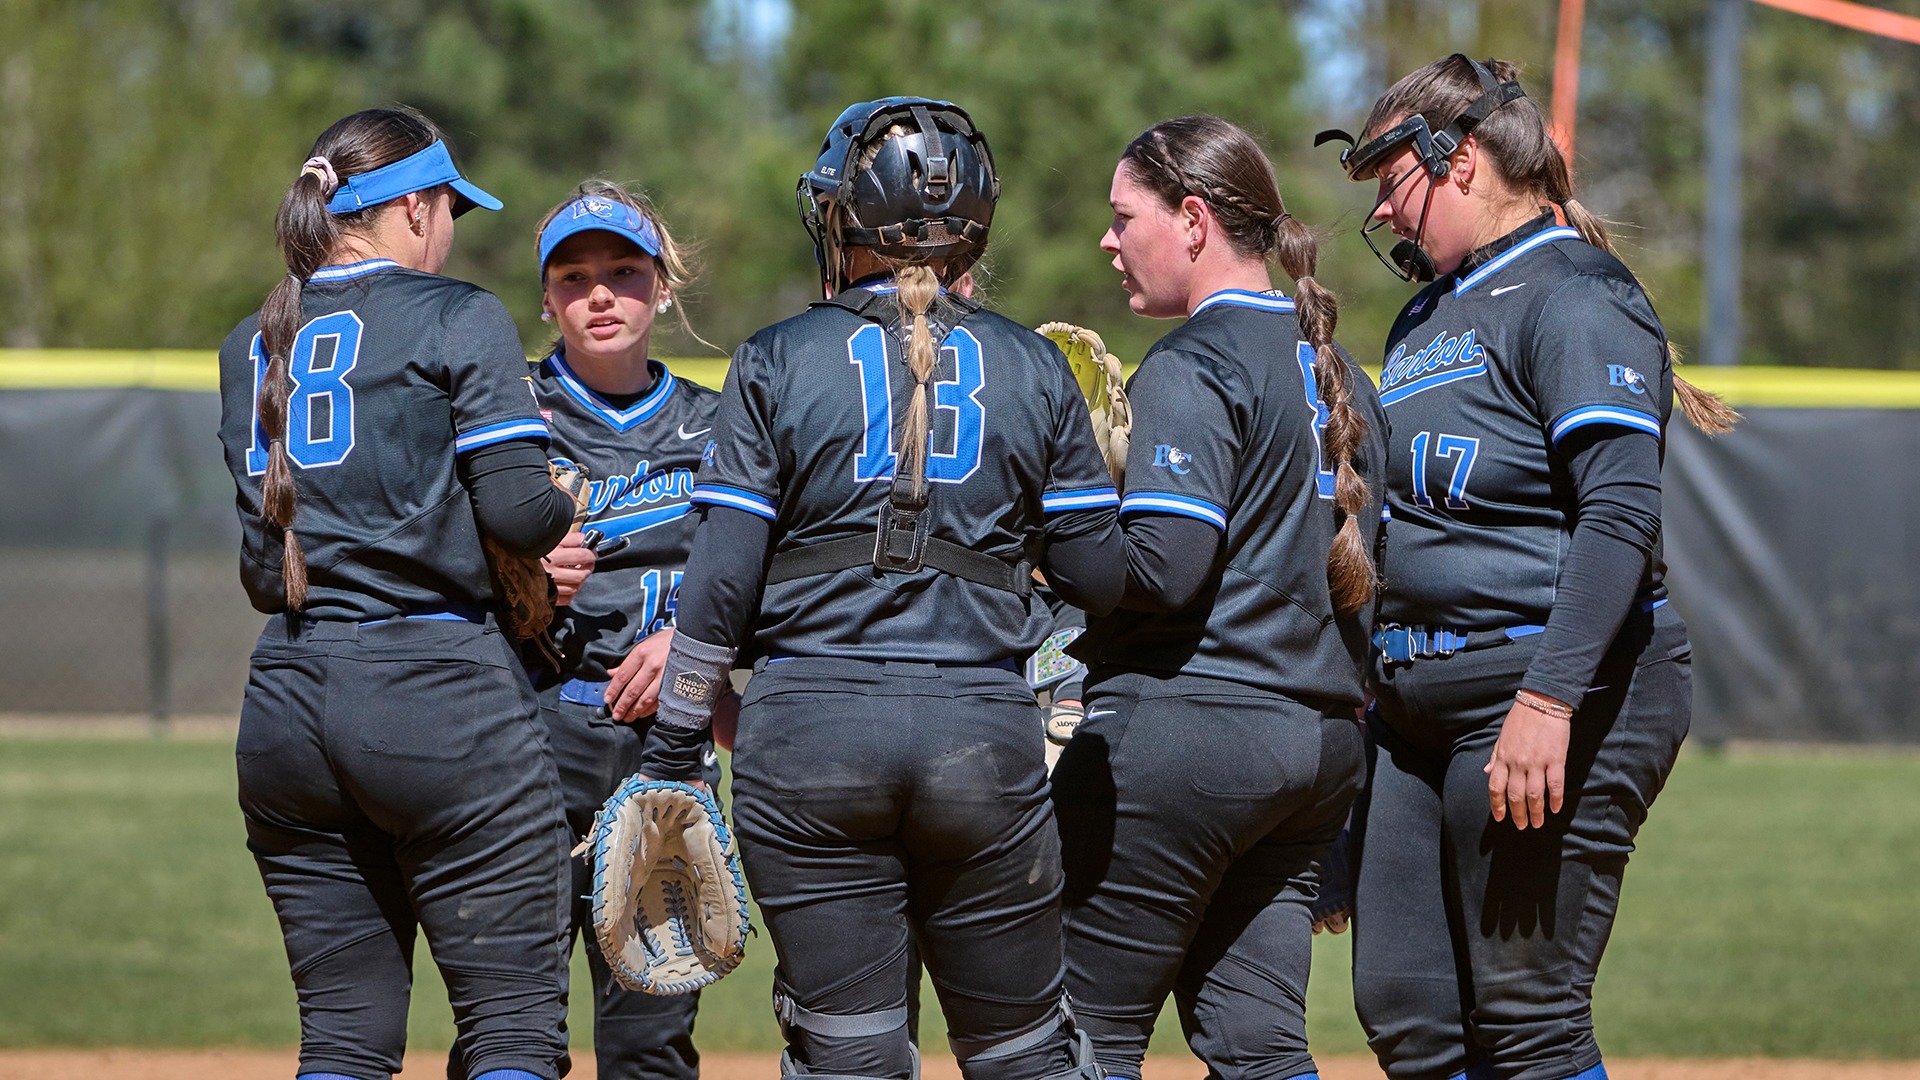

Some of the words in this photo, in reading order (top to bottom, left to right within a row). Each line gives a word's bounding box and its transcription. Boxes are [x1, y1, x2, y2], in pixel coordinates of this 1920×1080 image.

[820, 166, 837, 176] ELITE
[1378, 328, 1484, 394] Barton
[1606, 364, 1646, 395] BC
[246, 309, 364, 477] 18
[846, 323, 985, 484] 13
[565, 459, 694, 515] arton
[1152, 444, 1192, 475] BC
[1411, 431, 1480, 510] 17
[674, 681, 706, 696] ZONE
